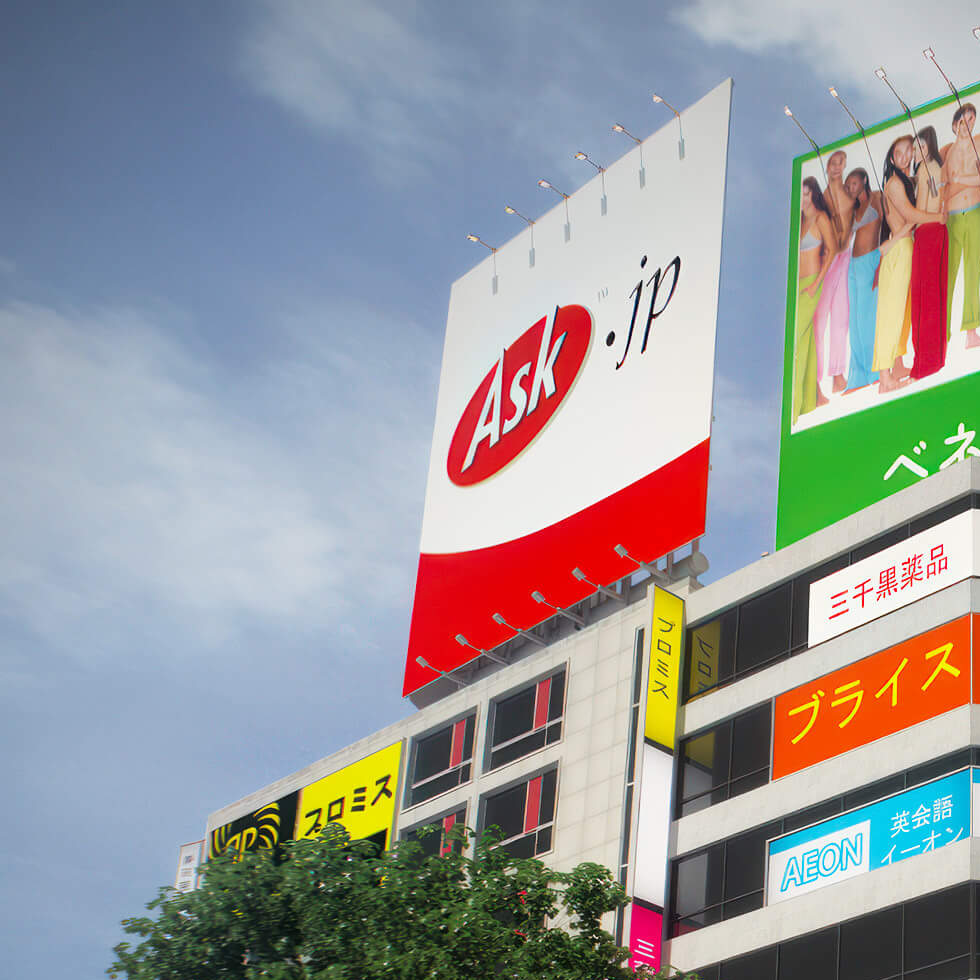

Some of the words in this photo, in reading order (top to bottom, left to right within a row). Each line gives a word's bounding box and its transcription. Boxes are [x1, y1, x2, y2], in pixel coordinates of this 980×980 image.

[828, 543, 949, 620] 三千黒薬品
[787, 642, 962, 745] ブライス
[780, 832, 864, 893] AEON
